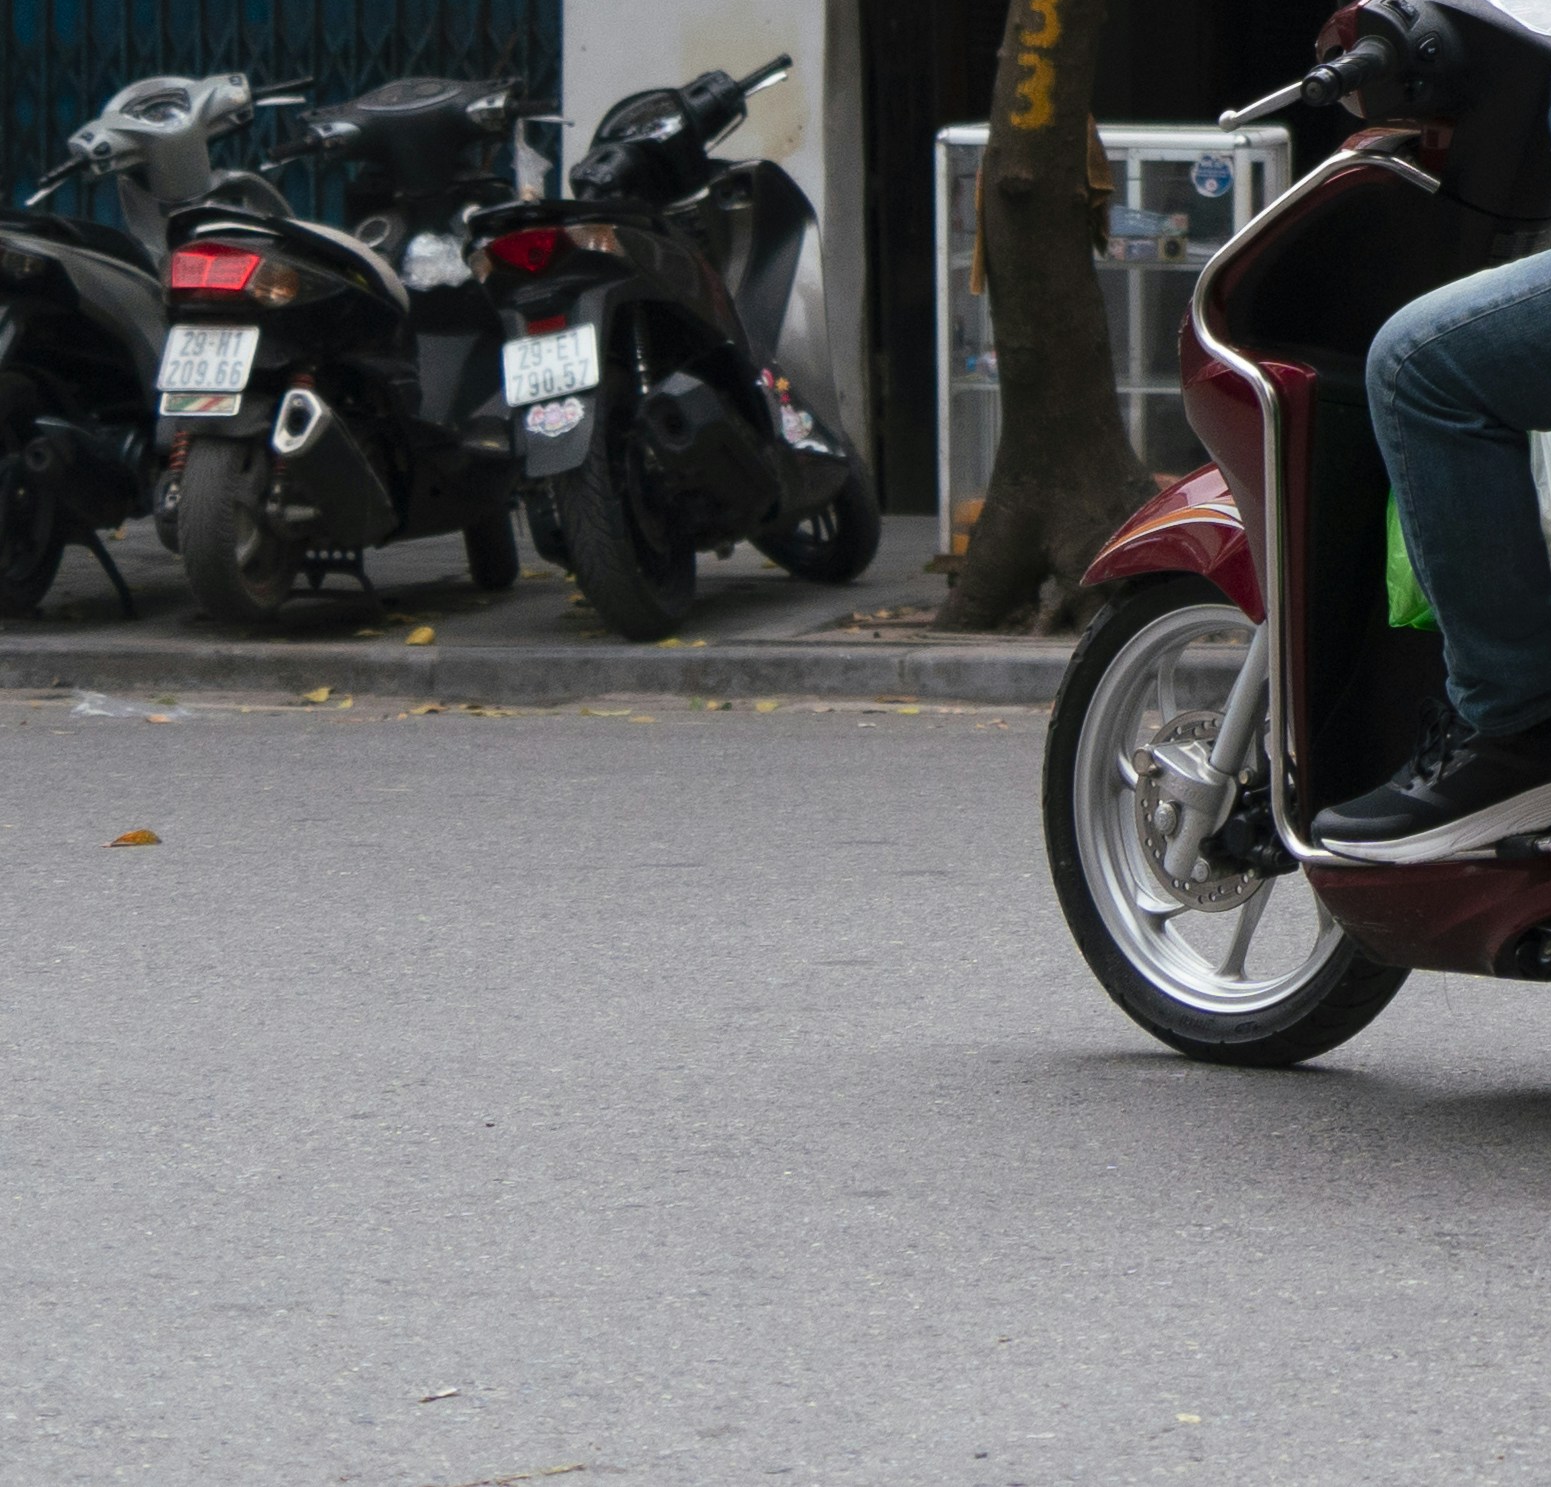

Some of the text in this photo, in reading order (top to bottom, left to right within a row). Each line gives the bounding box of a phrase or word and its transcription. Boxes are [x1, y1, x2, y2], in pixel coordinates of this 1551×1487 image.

[179, 330, 244, 358] 29-H1
[517, 331, 580, 371] 29-E1
[165, 359, 245, 387] 209.66
[511, 357, 590, 403] 790.57
